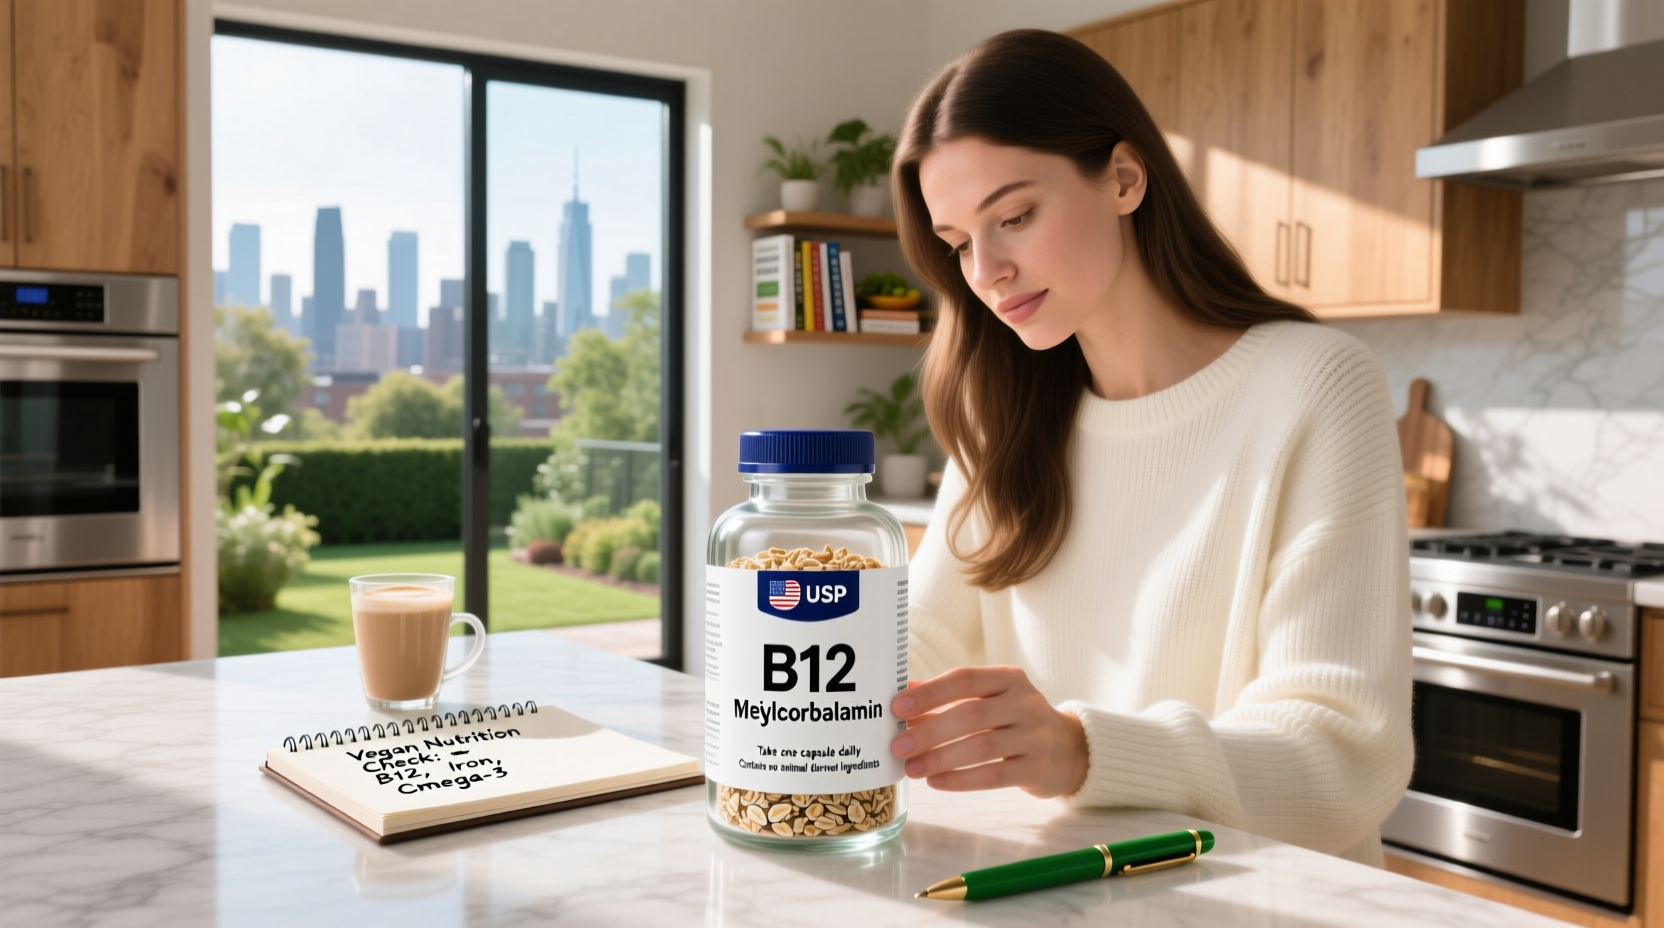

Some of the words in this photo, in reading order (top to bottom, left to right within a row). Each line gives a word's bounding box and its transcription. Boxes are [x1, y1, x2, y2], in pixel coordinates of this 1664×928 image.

[806, 585, 847, 603] USP
[763, 643, 856, 693] B12
[346, 744, 419, 761] Vegan
[423, 728, 521, 750] Nutrition
[362, 753, 441, 773] Check:
[375, 768, 430, 785] B12,
[448, 757, 502, 772] Iron,
